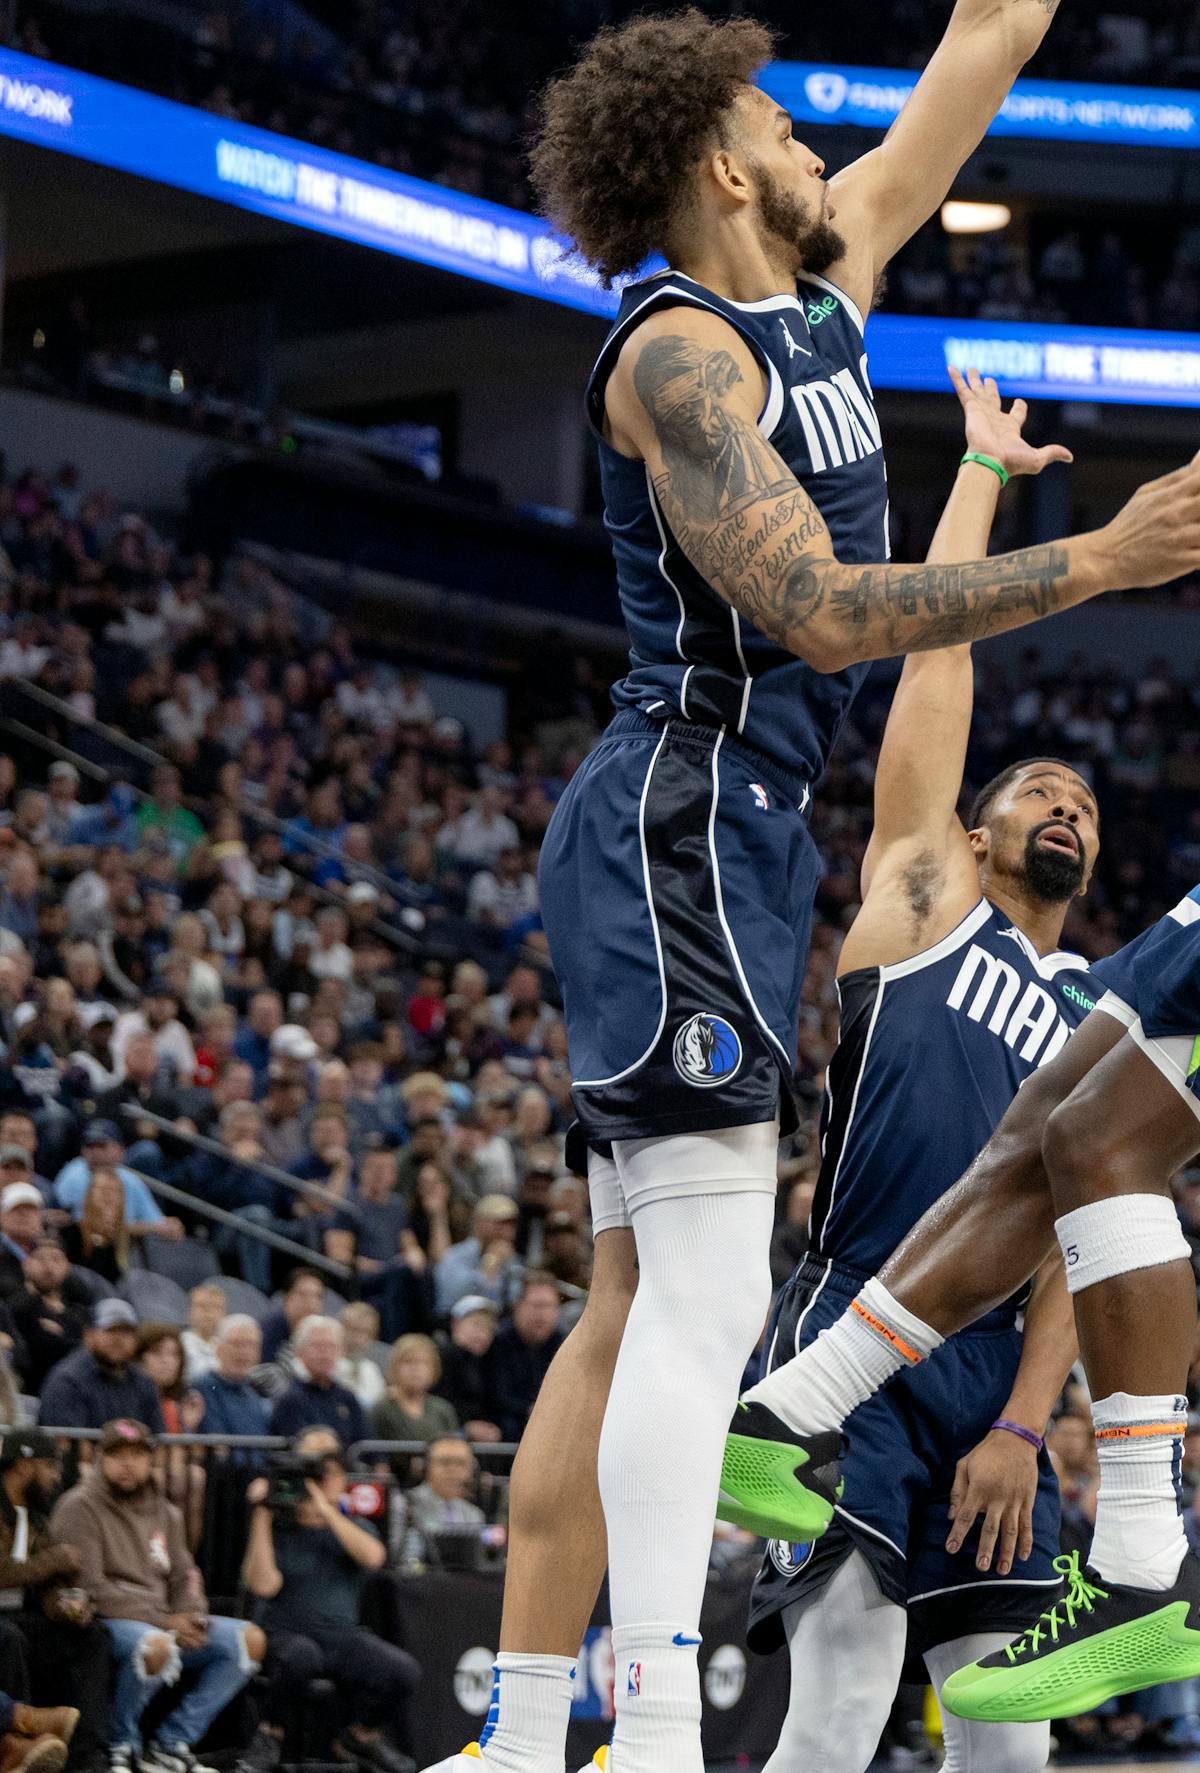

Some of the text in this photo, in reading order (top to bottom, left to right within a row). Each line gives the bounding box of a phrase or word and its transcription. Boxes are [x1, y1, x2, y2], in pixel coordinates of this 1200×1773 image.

[216, 139, 297, 202] WATCH
[297, 163, 338, 214] THE
[341, 175, 496, 262] TIMBERWOLVES
[497, 225, 528, 273] ON
[1045, 343, 1094, 384] THE
[1067, 1244, 1080, 1266] 5
